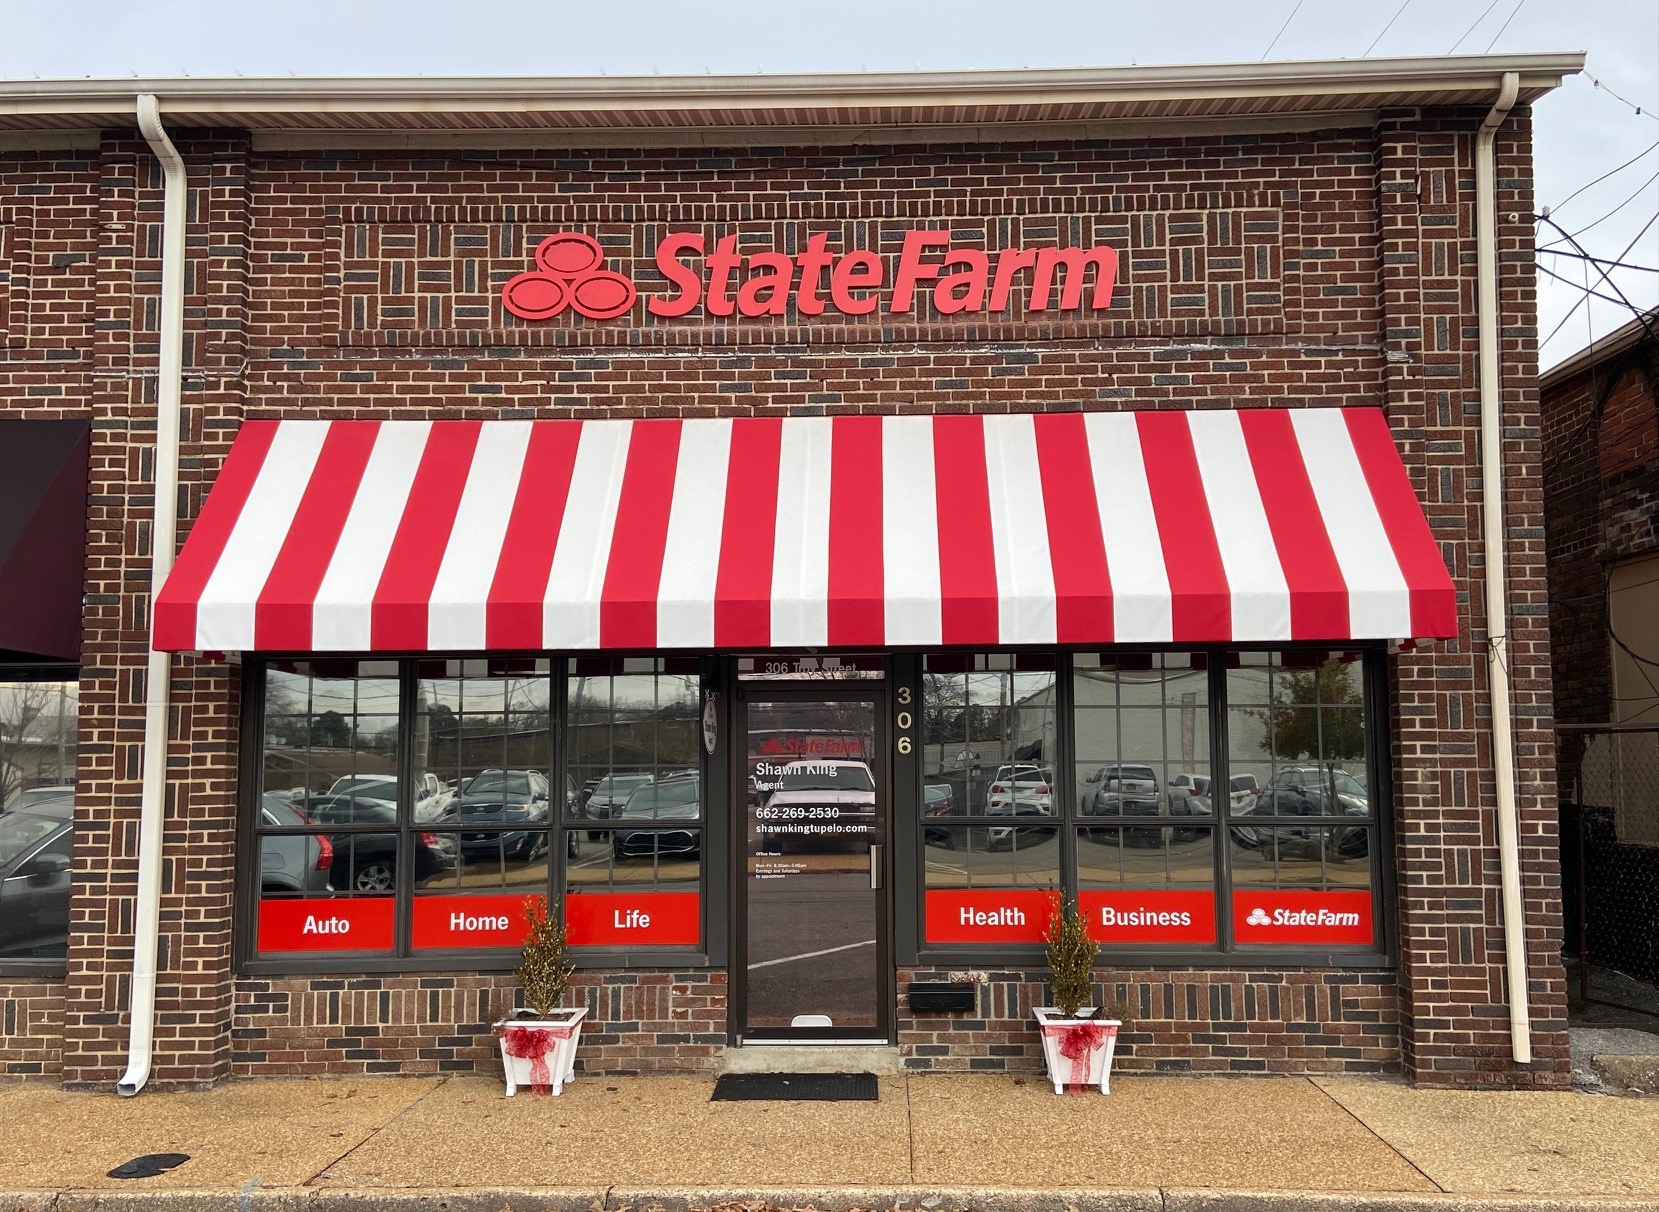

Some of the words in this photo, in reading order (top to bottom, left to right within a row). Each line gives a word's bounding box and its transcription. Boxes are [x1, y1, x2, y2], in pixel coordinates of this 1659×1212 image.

[765, 662, 789, 674] 306
[756, 762, 802, 776] Shawn
[806, 763, 838, 777] King
[756, 780, 784, 791] Agent
[756, 807, 840, 819] 662-269-2530
[755, 823, 868, 834] shawnkingtupelo.com
[302, 914, 351, 936] Auto
[449, 911, 510, 932] Home
[613, 909, 651, 929] Life
[959, 907, 1026, 927] Health
[1101, 907, 1191, 927] Business
